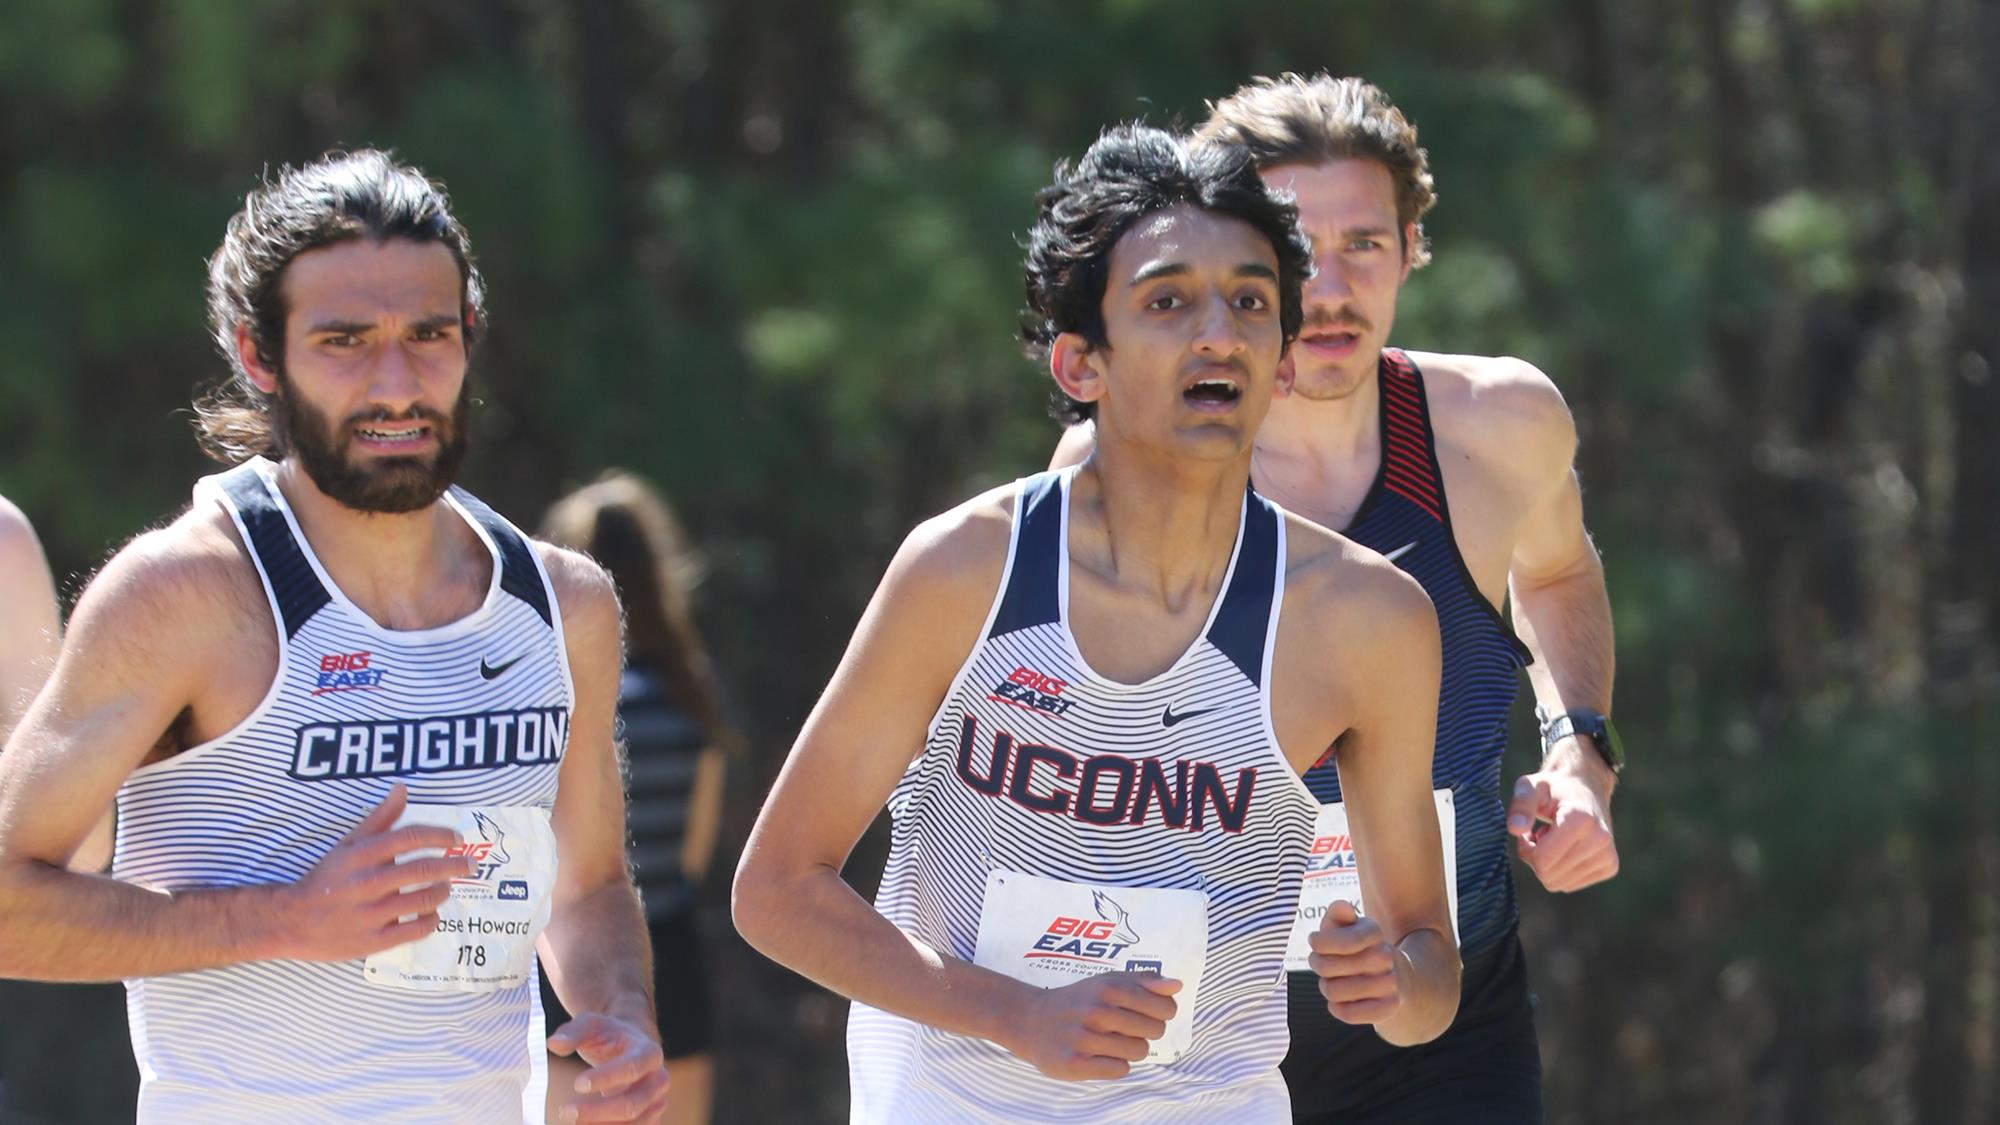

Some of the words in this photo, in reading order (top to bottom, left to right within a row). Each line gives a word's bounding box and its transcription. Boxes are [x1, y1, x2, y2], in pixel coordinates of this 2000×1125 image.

[321, 651, 371, 672] BIG
[317, 668, 388, 688] EAST
[1008, 666, 1067, 696] BIG
[994, 682, 1076, 714] EAST
[294, 709, 568, 778] CREIGHTON
[957, 713, 1257, 834] UCONN
[500, 883, 526, 898] Jeep
[434, 919, 464, 933] ase
[468, 916, 531, 935] Howard
[1046, 916, 1118, 940] BIG
[456, 944, 486, 967] 178
[1033, 934, 1131, 959] EAST
[1040, 958, 1071, 967] CROSS
